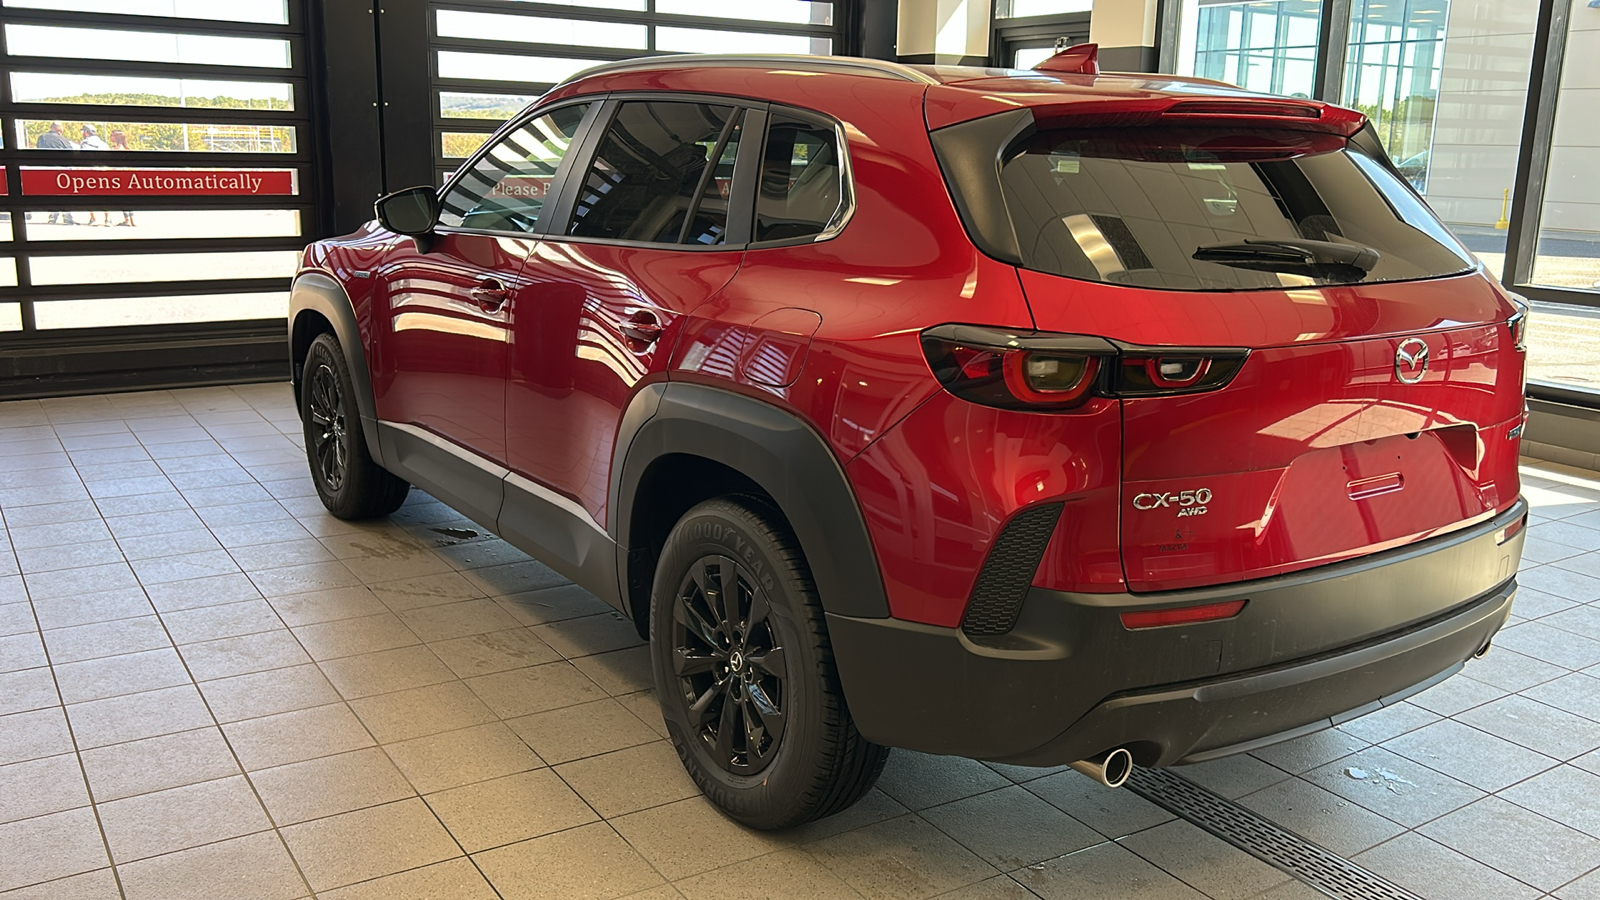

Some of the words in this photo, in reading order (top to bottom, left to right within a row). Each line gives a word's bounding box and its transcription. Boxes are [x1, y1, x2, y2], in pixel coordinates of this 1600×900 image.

[56, 173, 121, 193] Opens
[128, 173, 262, 193] Automatically
[492, 181, 538, 196] Please
[1132, 487, 1213, 510] CX-50
[1177, 506, 1208, 518] AWD
